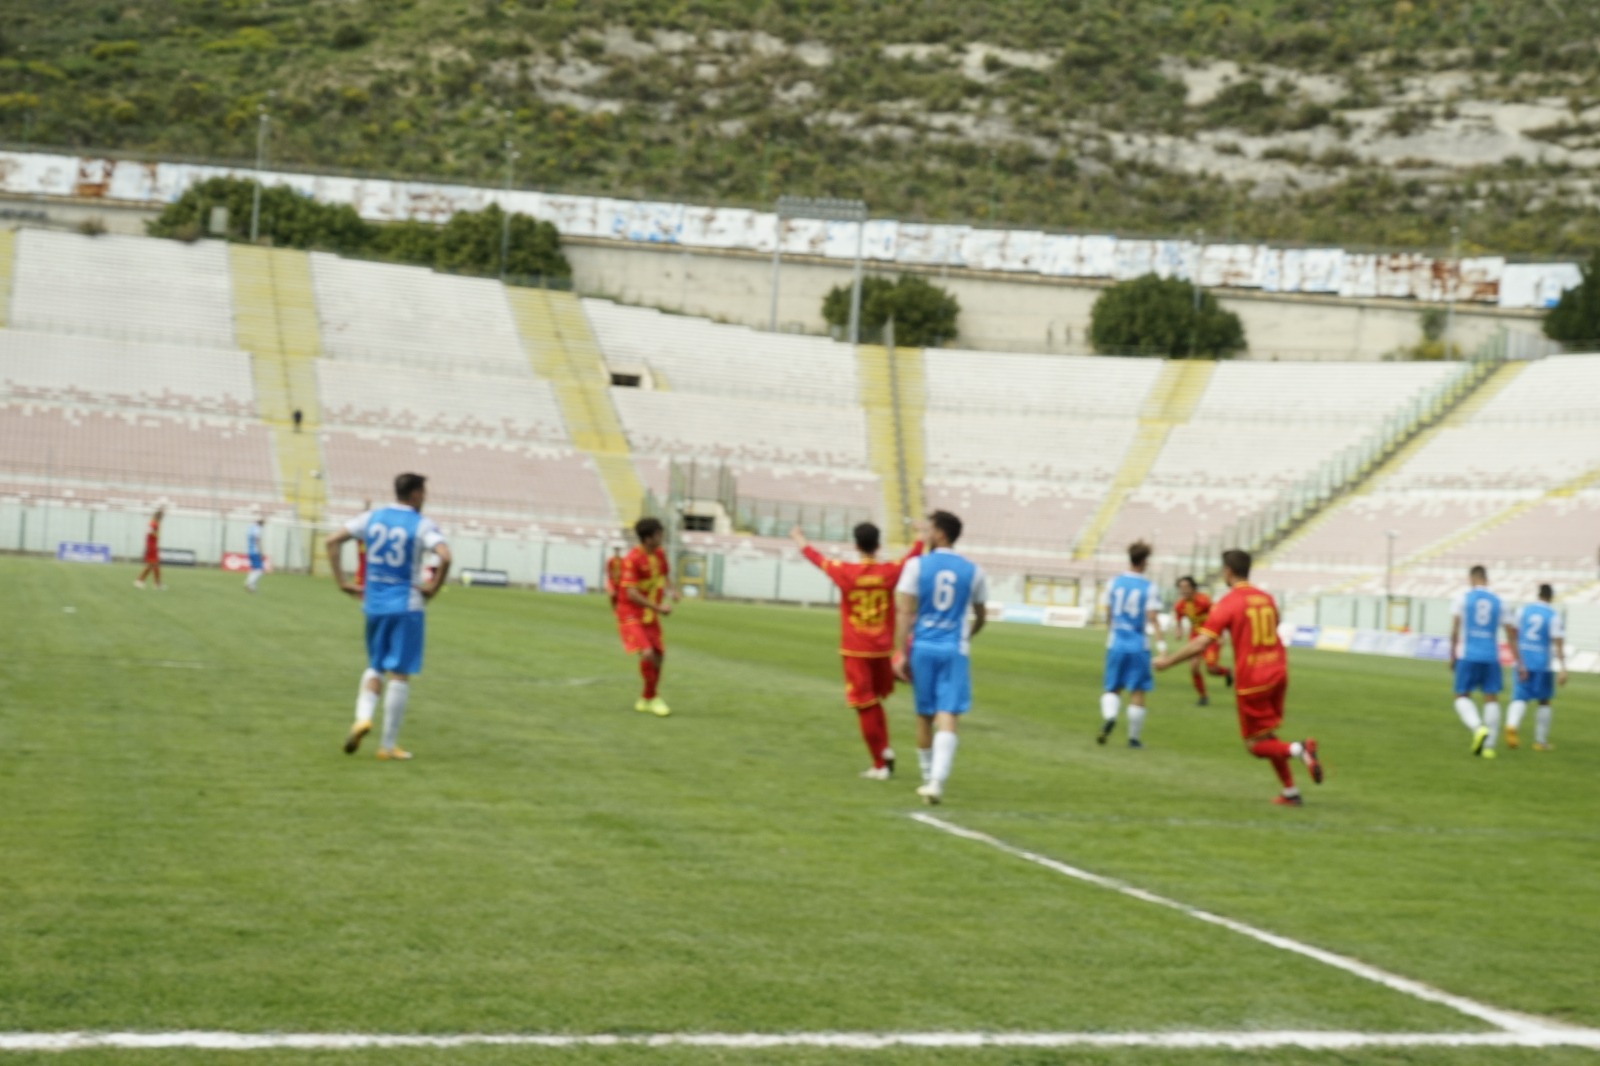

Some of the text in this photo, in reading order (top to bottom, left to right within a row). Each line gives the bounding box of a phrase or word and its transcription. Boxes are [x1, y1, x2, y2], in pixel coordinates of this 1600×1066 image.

[367, 522, 408, 568] 23
[933, 569, 957, 611] 6
[1114, 587, 1141, 618] 14
[1245, 606, 1277, 647] 10
[1475, 598, 1493, 626] 8
[1526, 613, 1543, 641] 2
